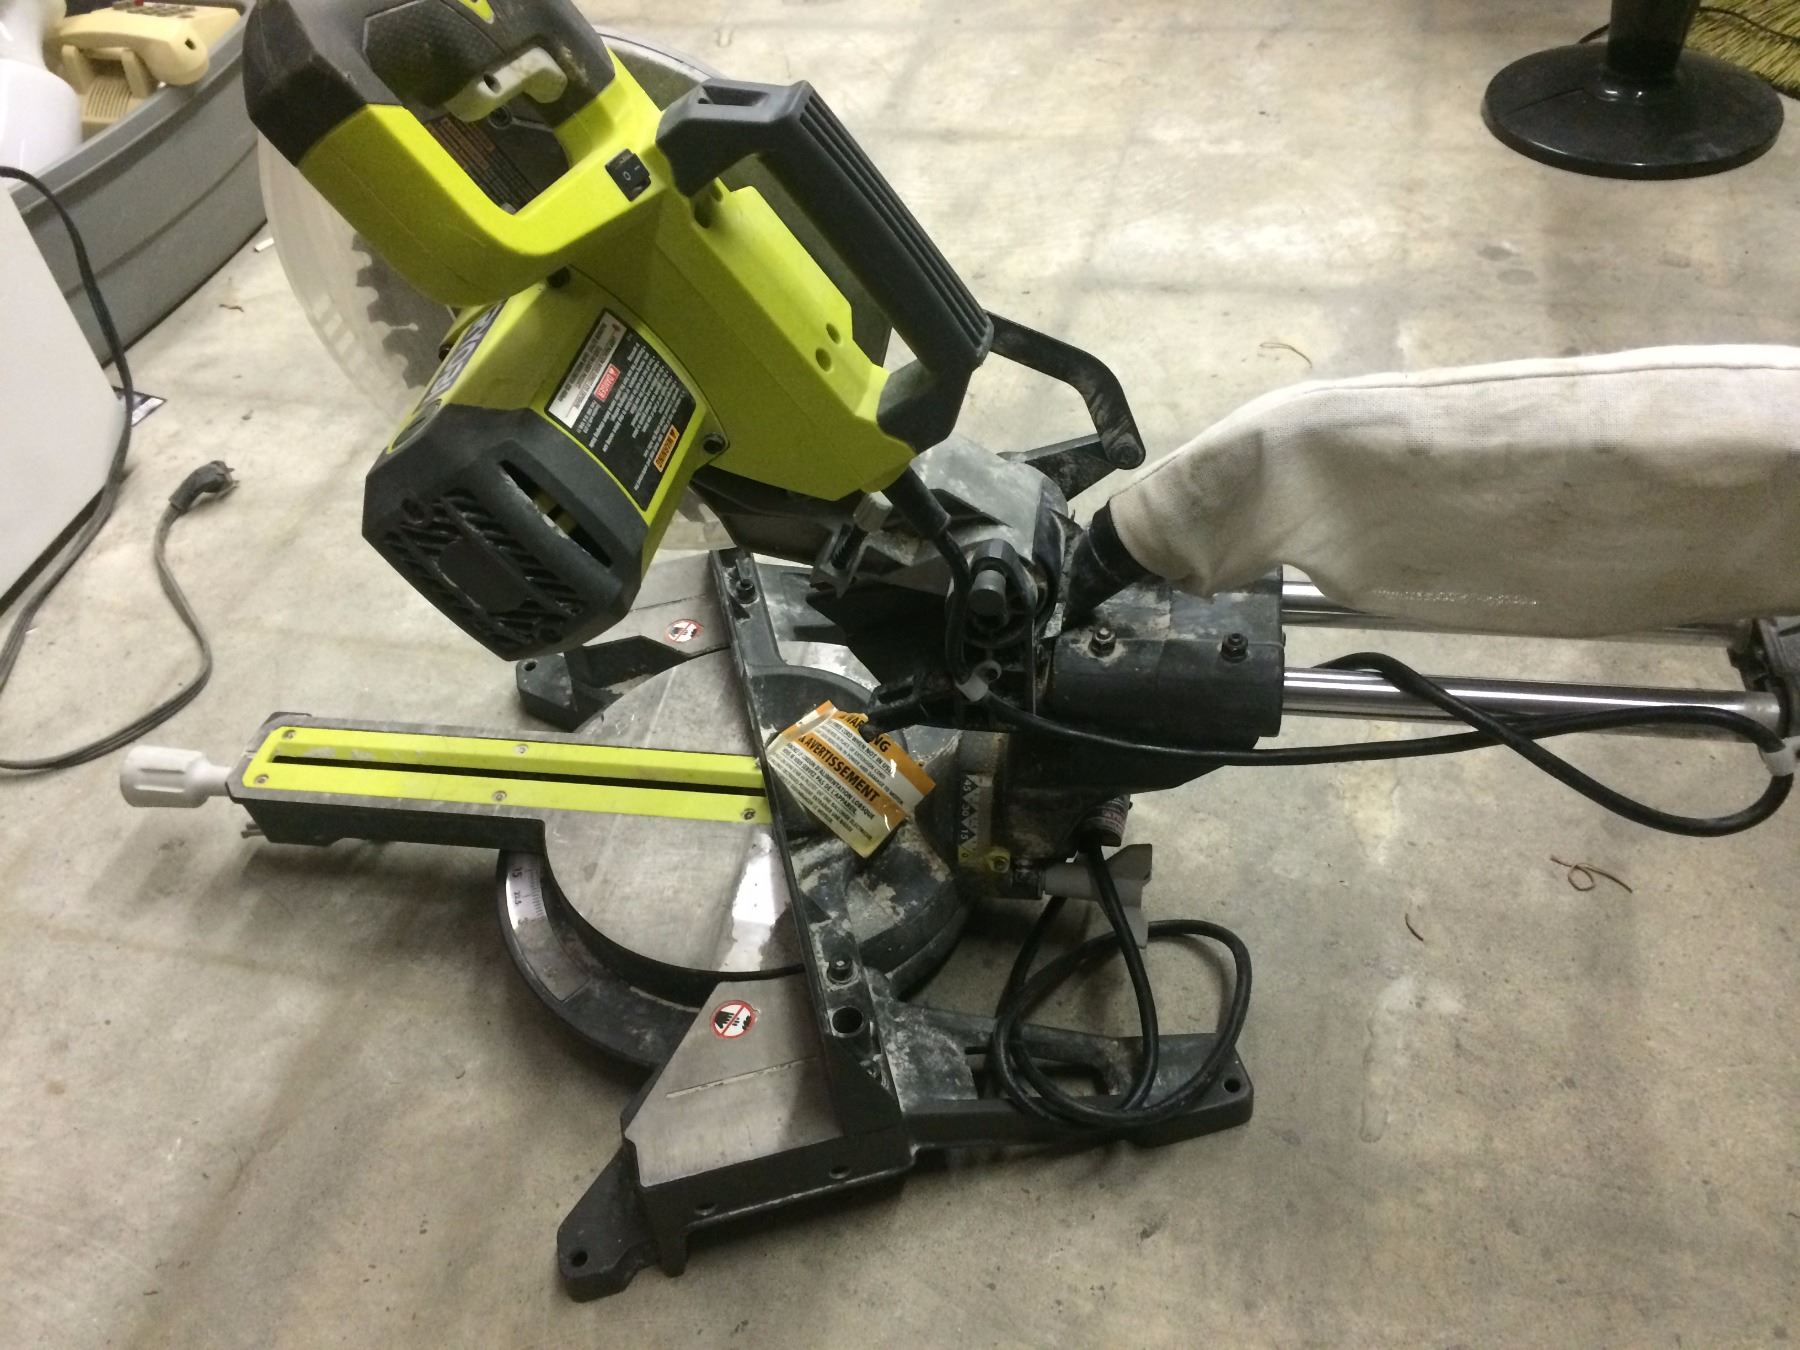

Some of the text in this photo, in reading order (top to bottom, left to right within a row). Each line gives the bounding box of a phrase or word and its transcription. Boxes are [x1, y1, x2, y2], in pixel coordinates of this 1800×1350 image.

[851, 735, 866, 750] WHEN
[864, 747, 877, 759] NOT
[875, 756, 883, 765] IN
[803, 735, 881, 803] AVERTISSEMENT
[814, 775, 825, 785] PAS
[823, 783, 831, 791] DE
[961, 829, 969, 840] 15
